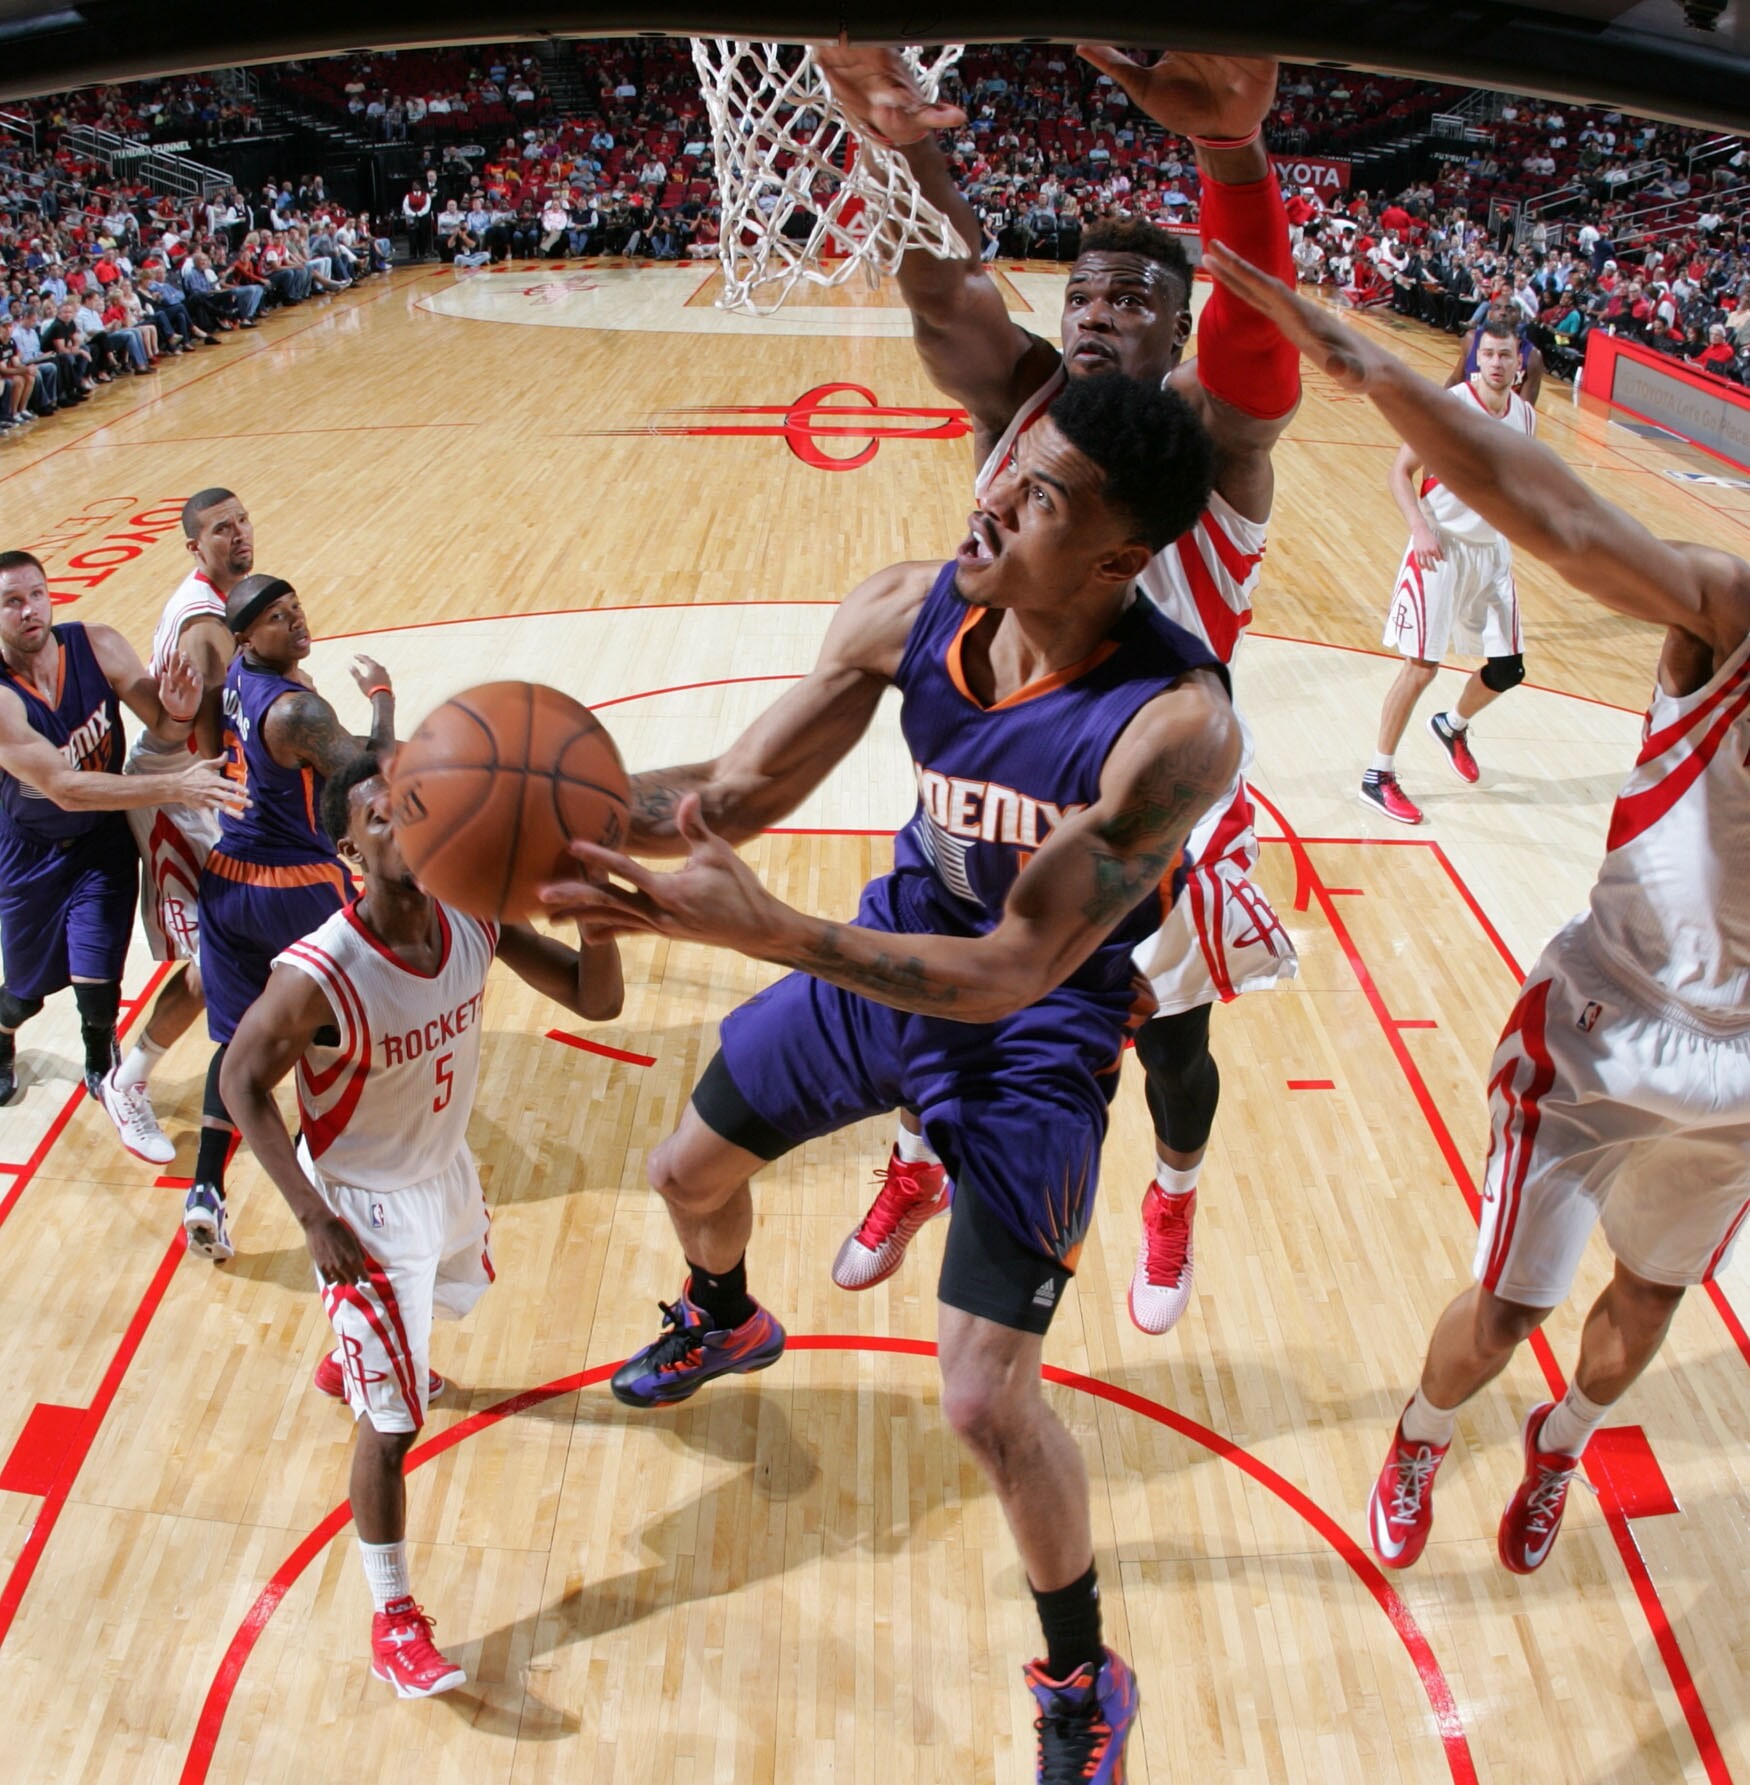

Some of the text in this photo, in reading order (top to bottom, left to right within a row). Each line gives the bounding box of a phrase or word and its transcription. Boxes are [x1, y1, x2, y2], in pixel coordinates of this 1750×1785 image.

[1270, 161, 1340, 188] YOTA
[916, 762, 1088, 848] OENIX
[433, 1051, 454, 1113] 5
